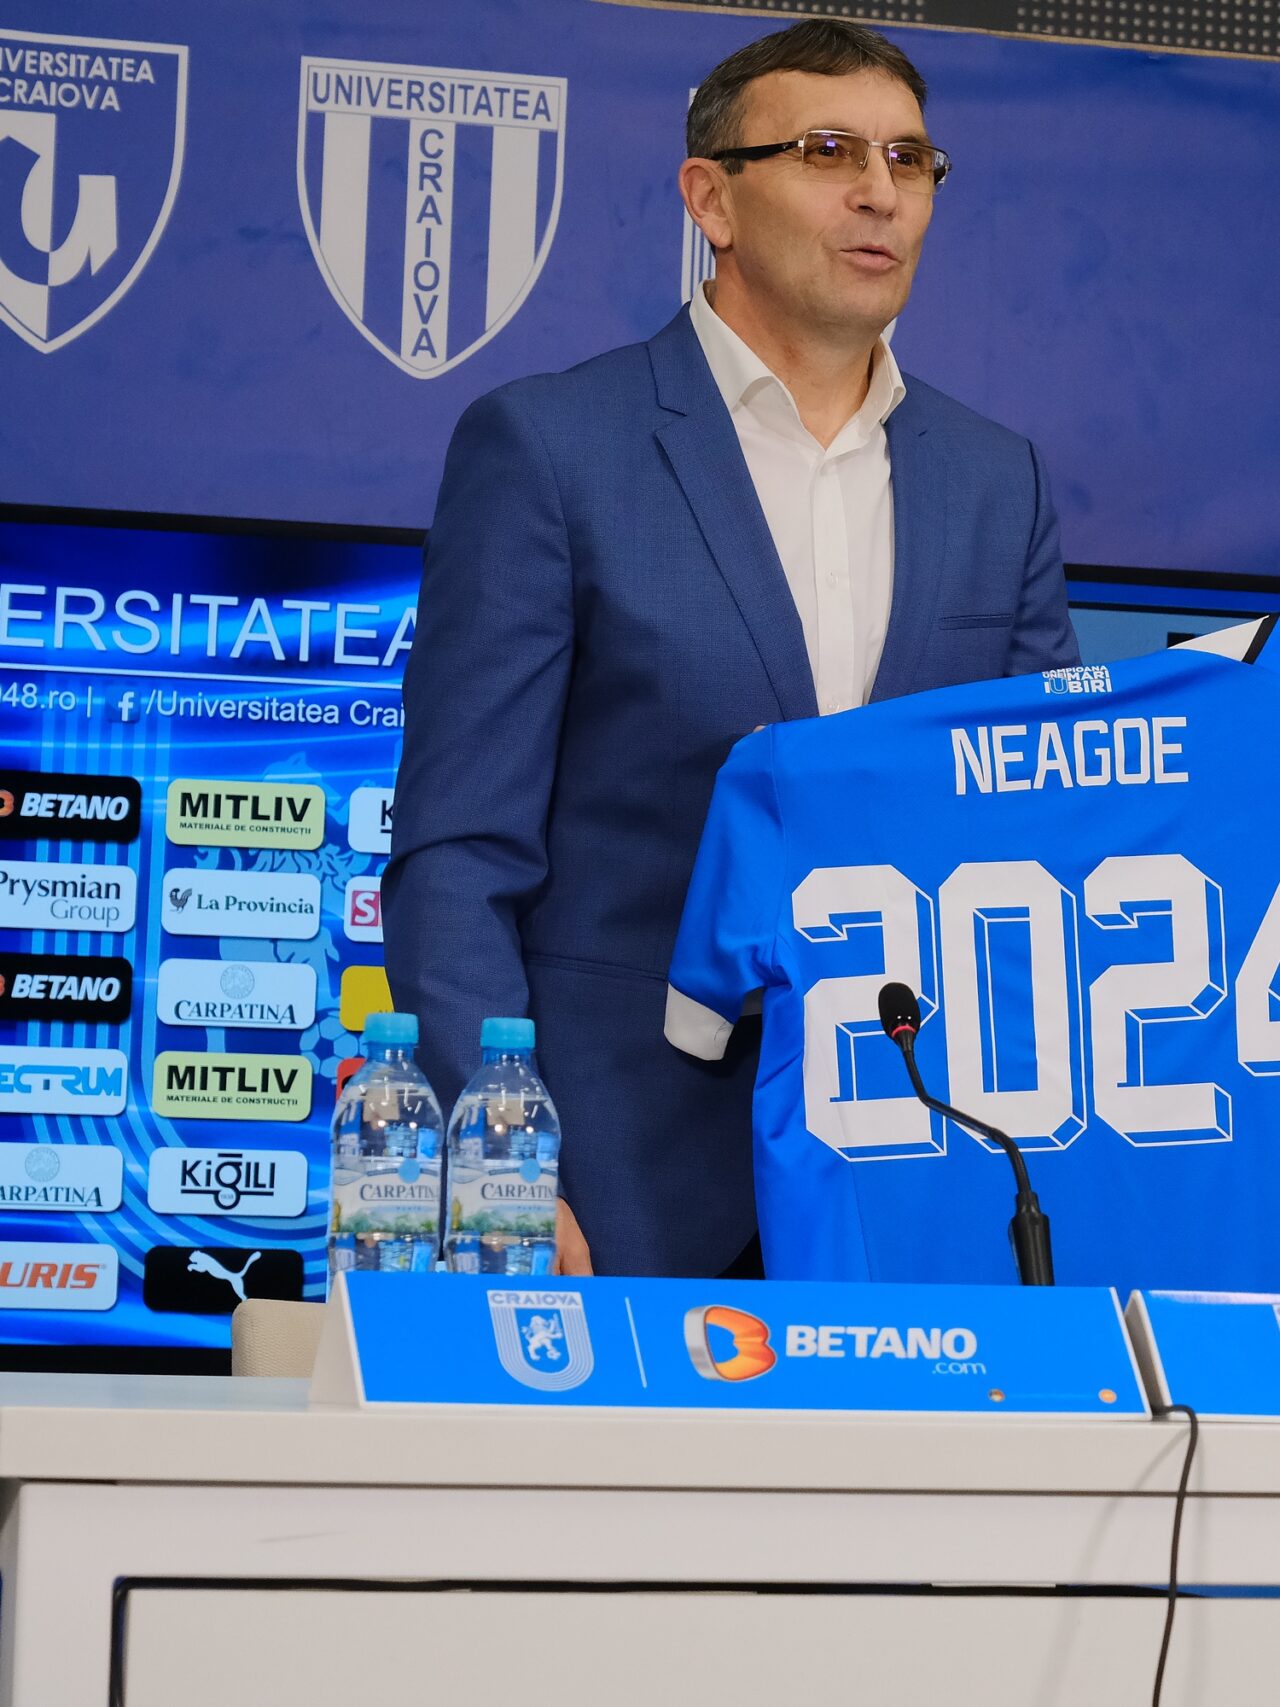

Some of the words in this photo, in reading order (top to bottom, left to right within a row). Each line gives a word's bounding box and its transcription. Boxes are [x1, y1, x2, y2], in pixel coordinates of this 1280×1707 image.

[0, 77, 120, 111] CRAIOVA
[311, 72, 552, 122] UNIVERSITATEA
[410, 128, 445, 359] CRAIOVA
[0, 681, 77, 711] 48.ro
[951, 716, 1190, 796] NEAGOE
[20, 792, 130, 821] BETANO
[180, 792, 312, 822] MITLIV
[179, 822, 231, 831] MATERIALE
[50, 898, 120, 928] Group
[196, 894, 219, 911] La
[224, 895, 314, 915] Provincia
[11, 973, 121, 1002] BETANO
[174, 999, 297, 1025] CARPATINA
[166, 1065, 299, 1094] MITLIV
[166, 1094, 218, 1103] MATERIALE
[221, 1096, 233, 1104] DE
[360, 1183, 440, 1202] CARPATIN
[481, 1182, 556, 1202] CARPATIN
[490, 1292, 579, 1306] CRAIOVA
[785, 1324, 978, 1360] BETANO
[932, 1361, 987, 1375] .com
